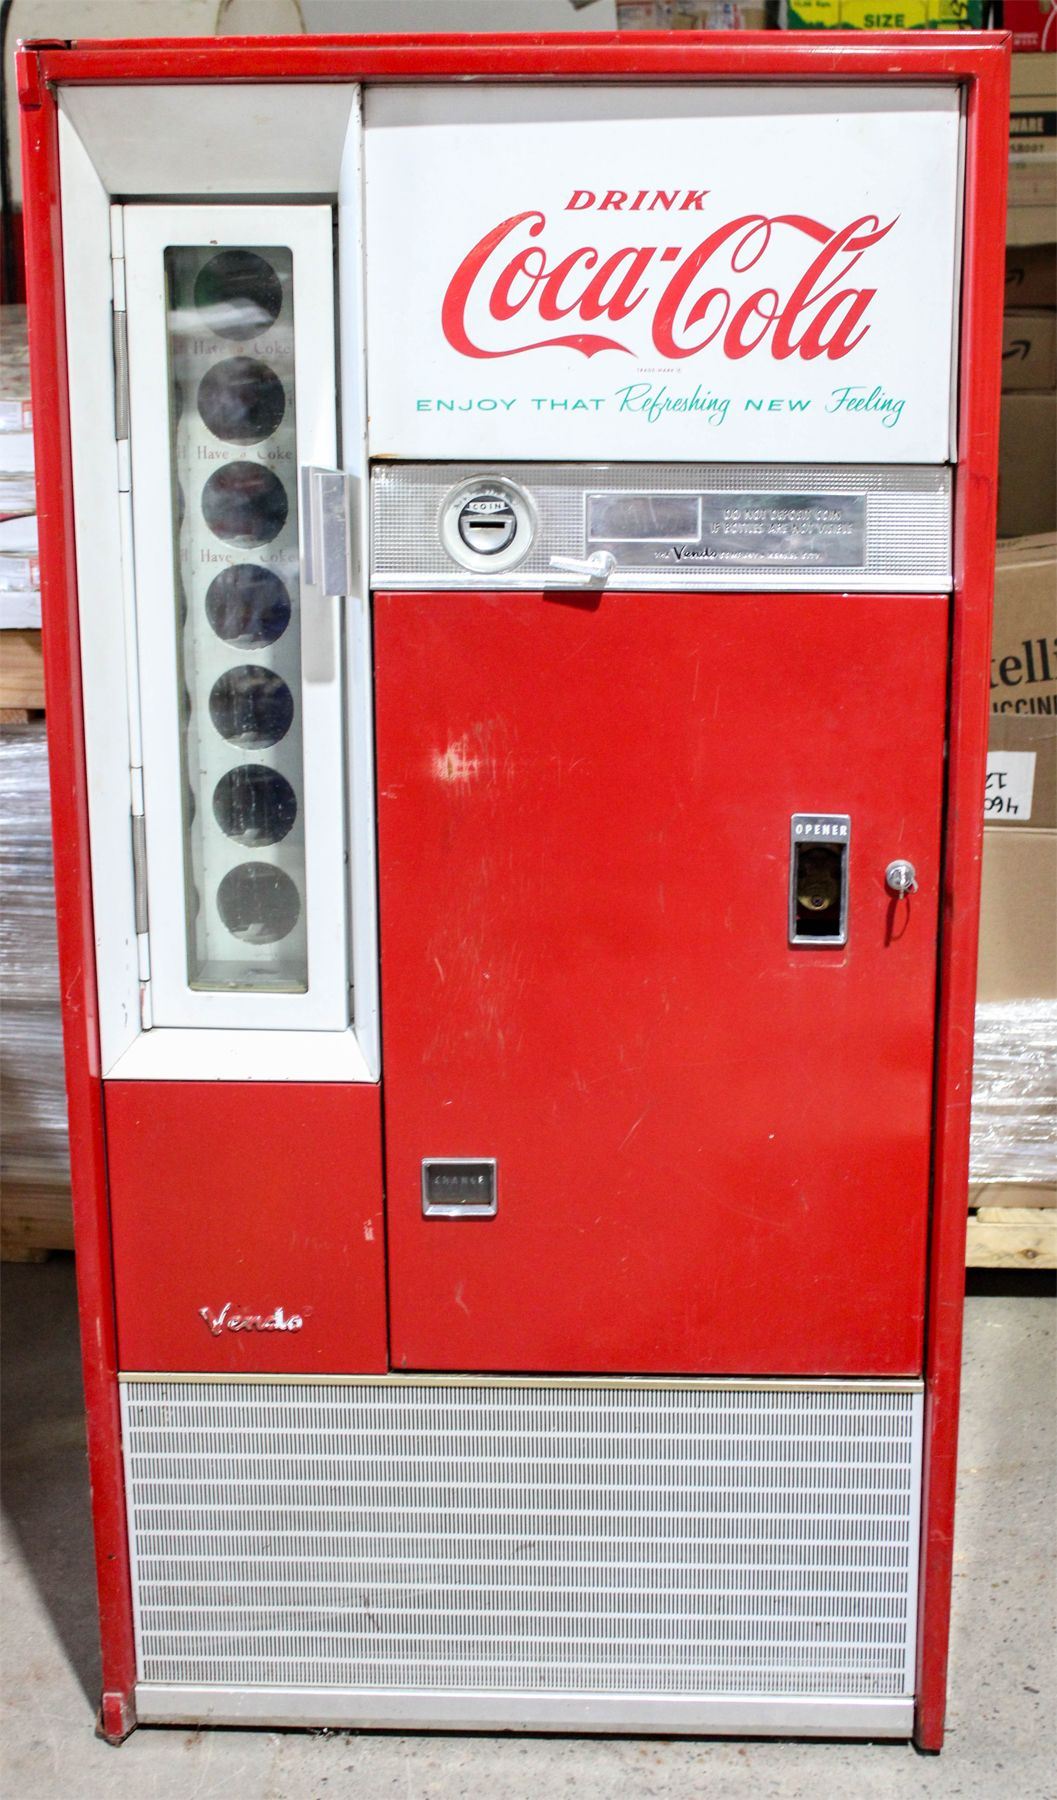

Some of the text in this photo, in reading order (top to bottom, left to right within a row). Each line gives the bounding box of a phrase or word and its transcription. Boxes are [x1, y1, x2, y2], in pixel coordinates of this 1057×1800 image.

[863, 13, 906, 28] SIZE
[564, 190, 712, 211] DRINK
[440, 211, 902, 361] Coca-Cola
[415, 382, 907, 428] ENJOY THAT Refreshing NEW Feeling
[197, 446, 230, 460] Have
[472, 503, 502, 511] COIN
[672, 544, 718, 562] Vendo
[795, 823, 848, 836] OPENER
[198, 1301, 304, 1337] Vendo
